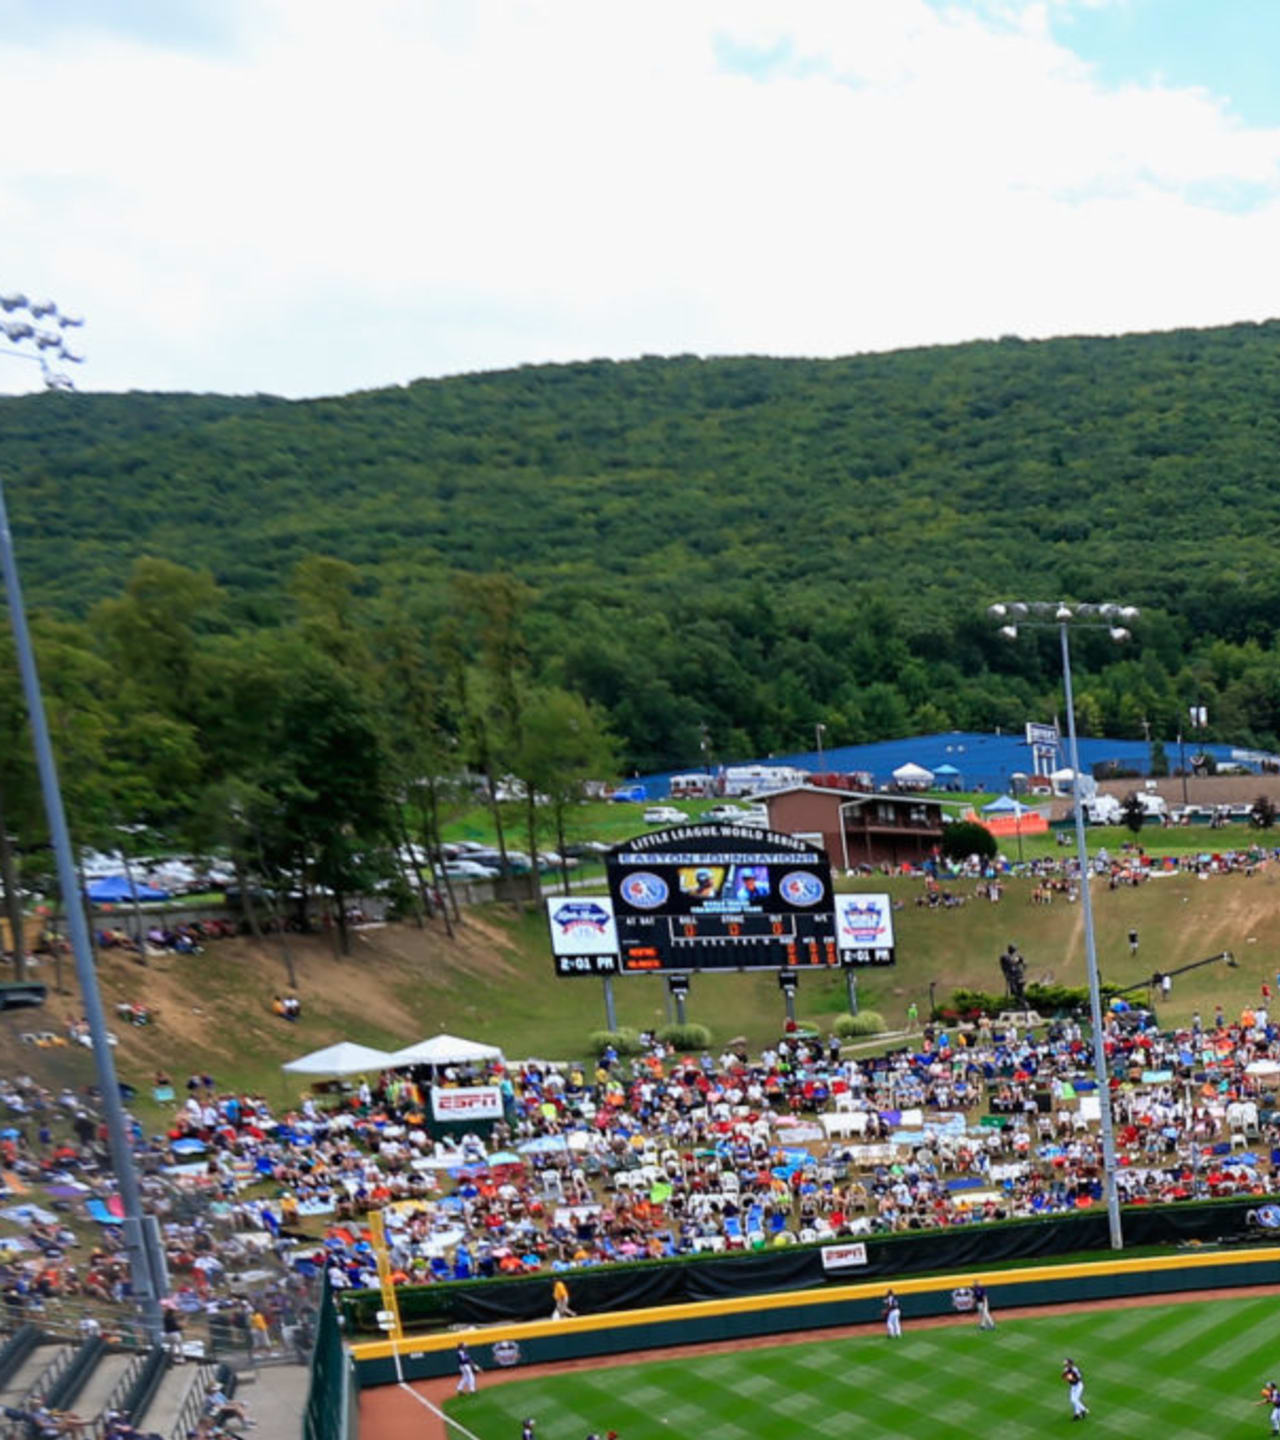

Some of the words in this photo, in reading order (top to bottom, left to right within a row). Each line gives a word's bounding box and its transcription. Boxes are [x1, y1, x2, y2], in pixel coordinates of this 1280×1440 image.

[631, 833, 669, 850] LITTLE
[673, 826, 719, 840] LEAGUE
[721, 826, 763, 840] WORLD
[766, 832, 806, 850] SERIES
[438, 1093, 496, 1109] ESPN
[825, 1248, 862, 1261] ESPN
